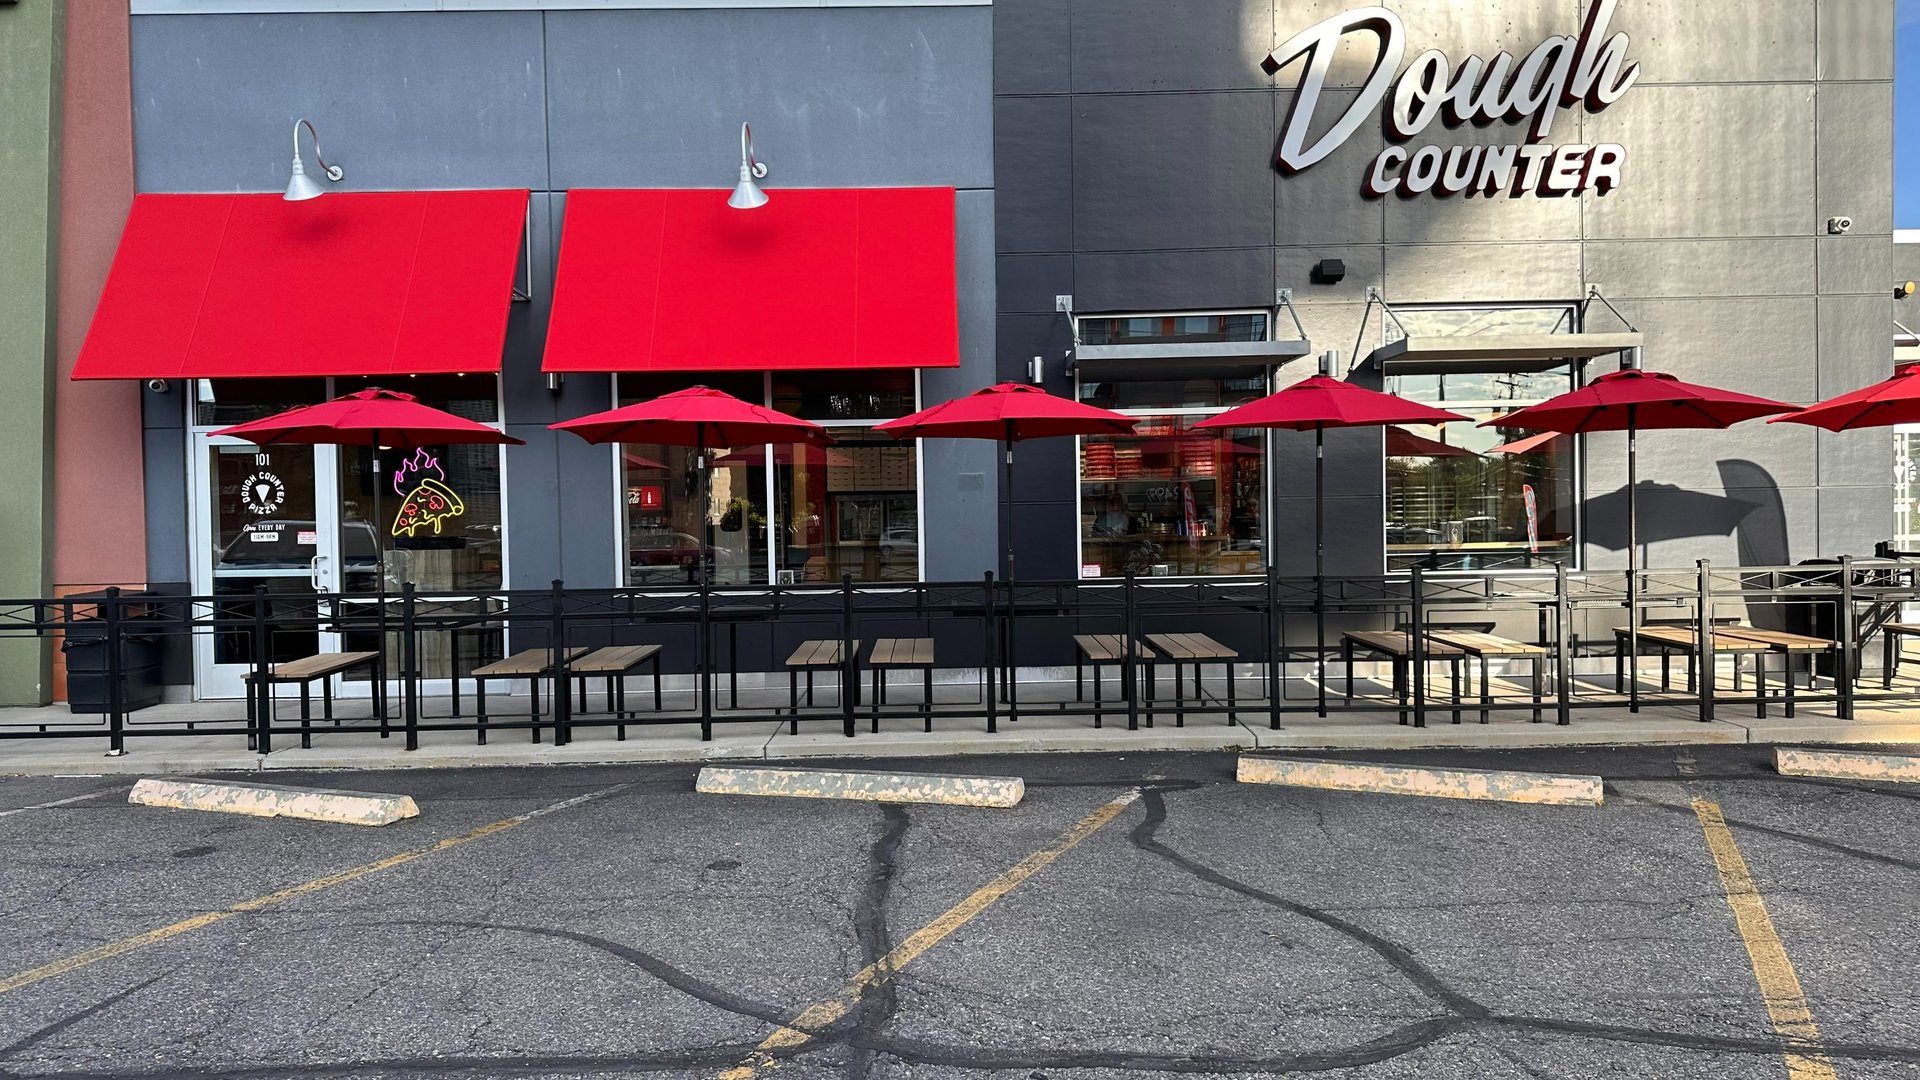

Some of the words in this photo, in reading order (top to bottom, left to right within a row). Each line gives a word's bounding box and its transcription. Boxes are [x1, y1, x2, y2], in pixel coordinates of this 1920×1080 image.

[1264, 0, 1641, 172] Dough
[1366, 143, 1627, 197] COUNTER
[256, 454, 269, 466] 101
[241, 474, 257, 504] DOUGH
[259, 472, 284, 504] COUNTER
[248, 503, 277, 514] PIZZA
